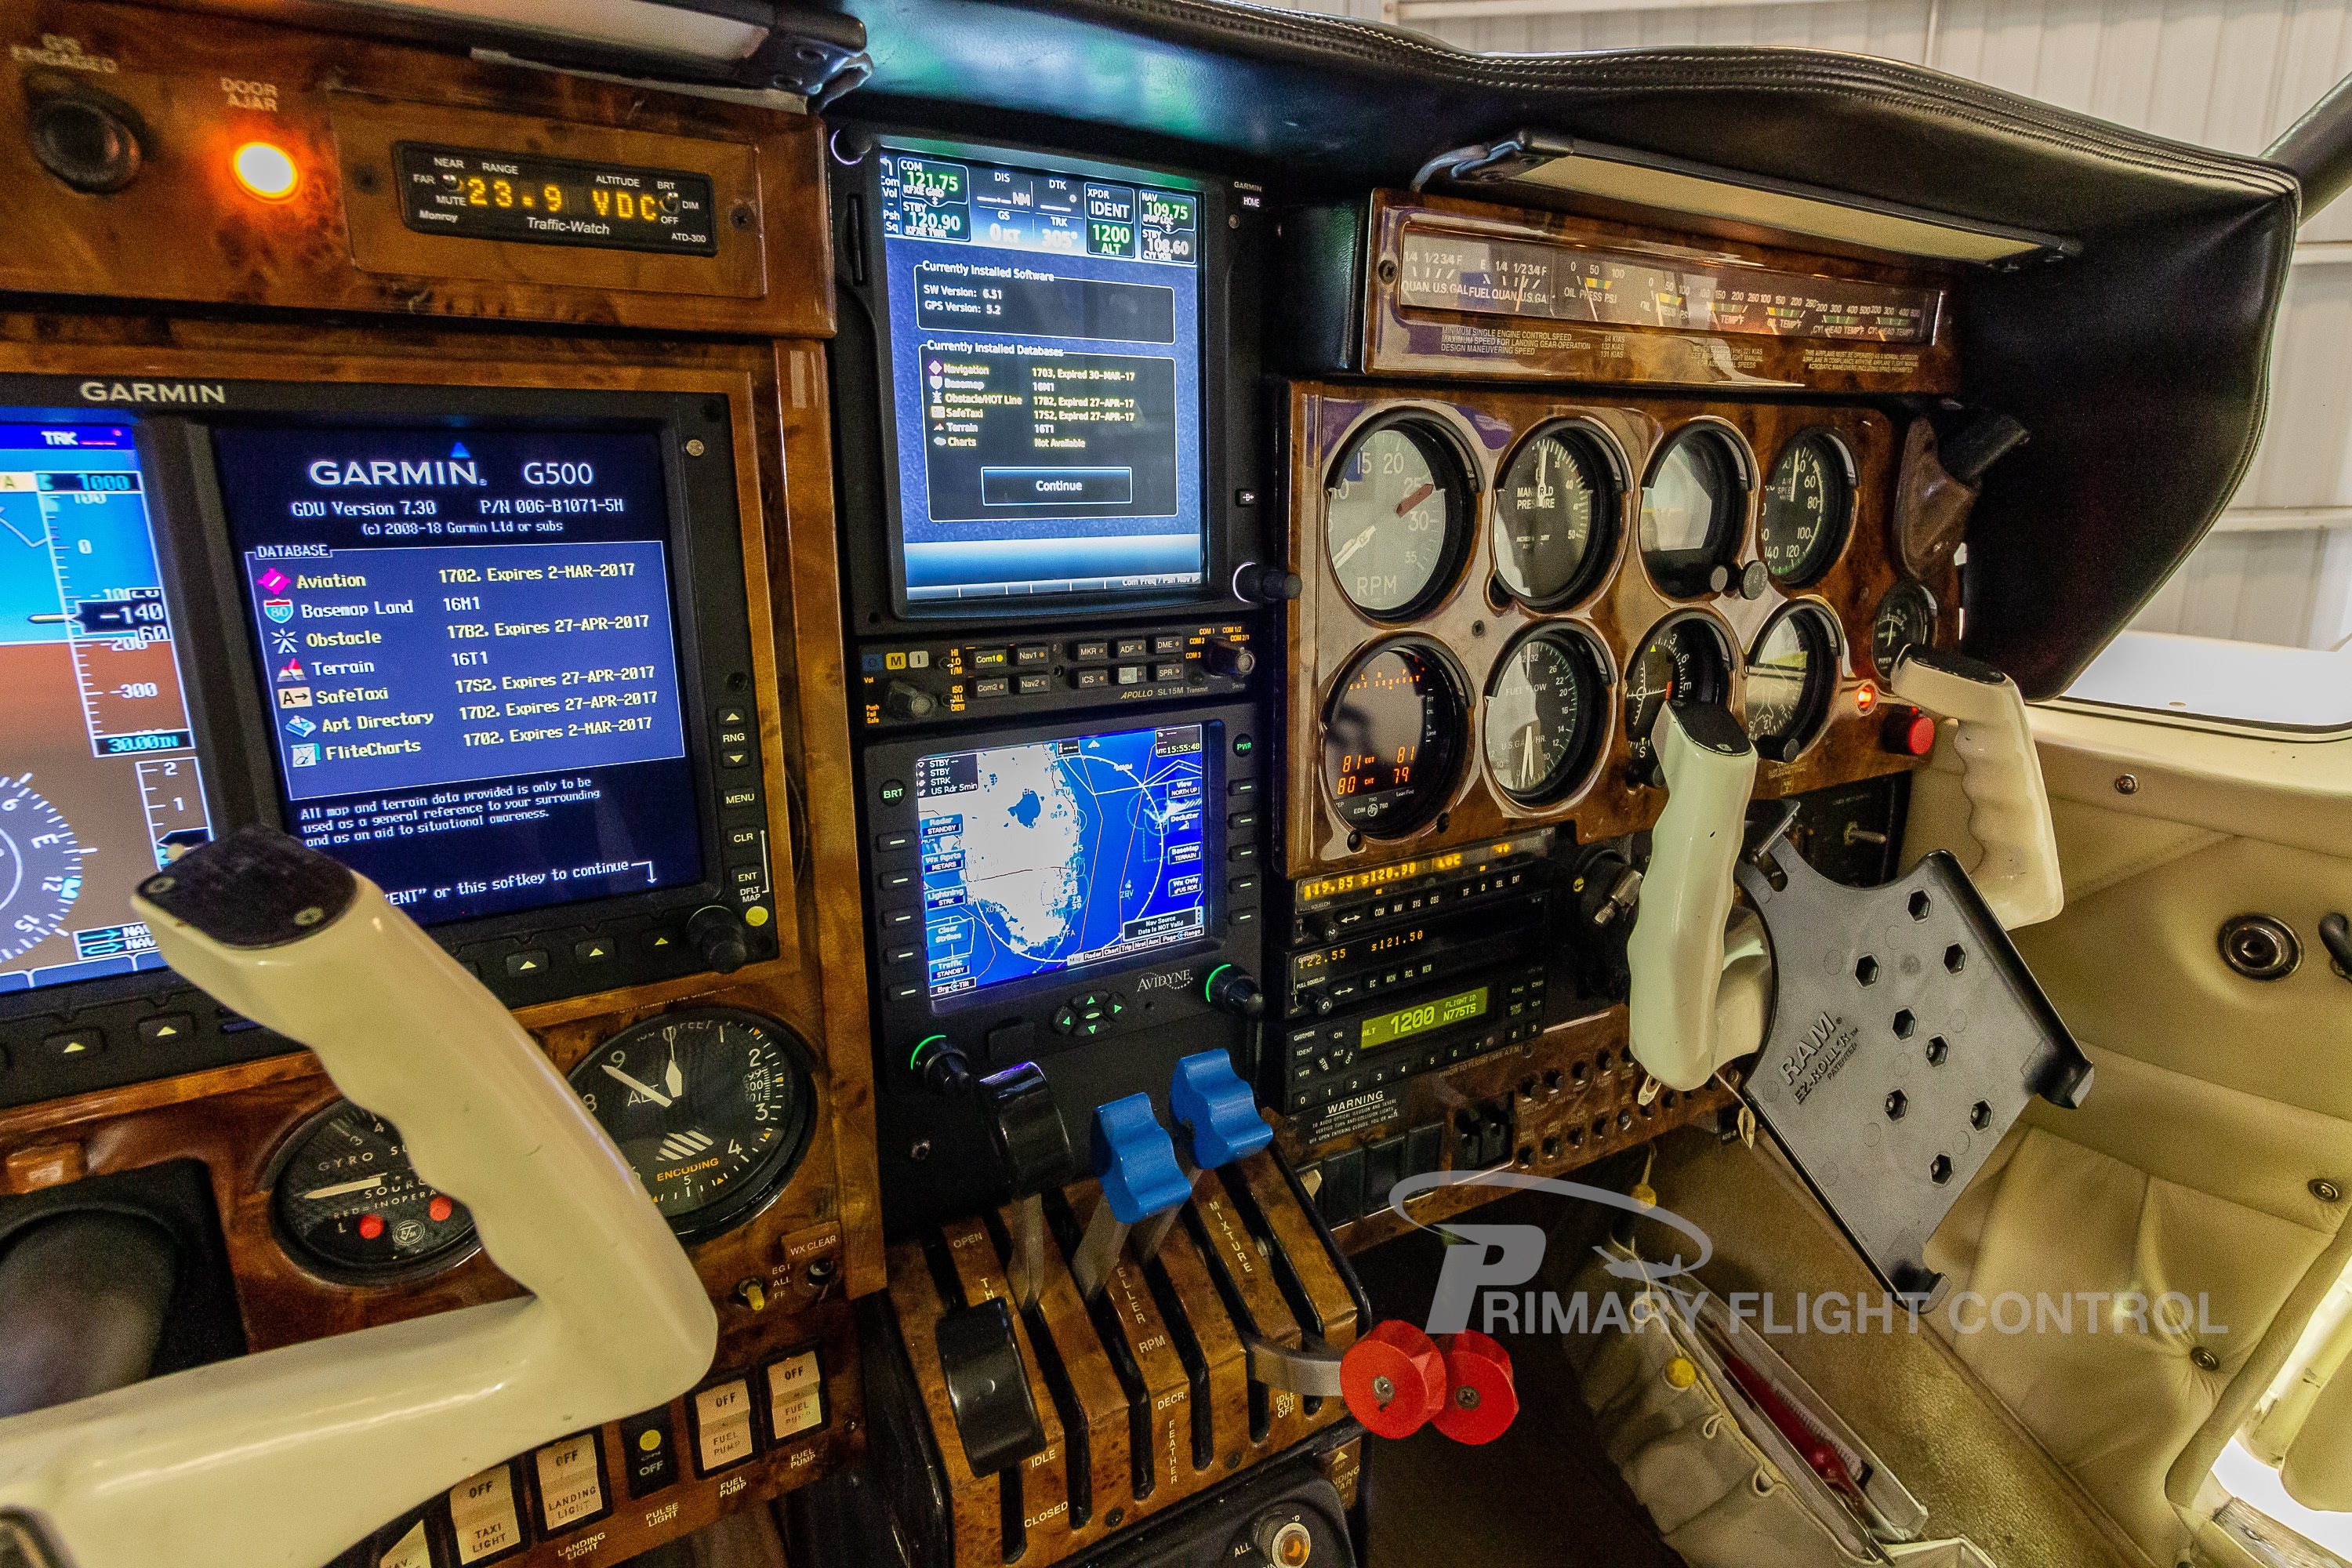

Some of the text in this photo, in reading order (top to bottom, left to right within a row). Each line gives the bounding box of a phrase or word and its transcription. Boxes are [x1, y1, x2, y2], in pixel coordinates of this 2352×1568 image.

[221, 77, 278, 98] DOOR
[228, 94, 278, 112] AJAR
[434, 158, 464, 169] NEAR
[482, 162, 518, 176] RANGE
[901, 160, 922, 172] COM
[413, 174, 435, 183] FAR
[596, 175, 640, 187] ALTITUDE
[657, 181, 675, 191] BRT
[907, 171, 958, 191] 121.75
[994, 172, 1010, 183] DIS
[1049, 180, 1066, 191] DTK
[1087, 188, 1109, 199] XPDR
[1234, 181, 1262, 192] GARMIN
[436, 195, 466, 206] MUTE
[591, 189, 657, 222] VDC
[682, 201, 699, 210] DIM
[1142, 192, 1157, 202] NAV
[1243, 197, 1260, 207] HOME
[903, 201, 927, 213] STBY
[1091, 201, 1130, 219] IDENT
[1146, 202, 1189, 220] 109.75
[419, 209, 458, 223] Monroy
[660, 216, 679, 225] OFF
[909, 212, 960, 231] 120.90
[1051, 216, 1068, 227] TRK
[527, 216, 610, 235] Traffic-Watch
[1092, 224, 1131, 244] 1200
[671, 233, 706, 244] ATD-300
[1102, 242, 1121, 255] ALT
[922, 260, 1054, 281] Currently Installed Software
[924, 284, 1002, 299] SW Version: 6.51
[924, 300, 1001, 315] GPS Version: 5.2
[927, 339, 1065, 357] Currently Installed Databases
[80, 381, 226, 405] GARMIN
[41, 430, 78, 446] TRK
[948, 437, 1085, 448] Charts Not Available
[1384, 453, 1404, 474] 20
[310, 460, 593, 487] GARMIN G500
[1804, 476, 1816, 488] 60
[80, 474, 131, 492] 1000
[1036, 480, 1083, 492] Continue
[291, 500, 436, 517] GDU Version 7.30
[1807, 496, 1818, 509] 80
[1409, 512, 1429, 531] 30
[1797, 527, 1811, 539] 100
[256, 544, 328, 559] DATABASE
[1786, 545, 1800, 557] 120
[296, 572, 366, 590] Aviation
[487, 566, 543, 583] Expires
[548, 561, 635, 580] 2-MAR-2017
[1357, 576, 1397, 597] RPM
[301, 599, 414, 619] Basemap Land
[306, 630, 382, 648] Obstacle
[495, 620, 550, 637] Expires
[554, 614, 650, 633] 27-APR-2017
[1157, 641, 1173, 649] DME
[312, 652, 488, 677] Terrain 16T1
[976, 655, 996, 663] Com1
[1082, 675, 1094, 684] ICS
[1159, 669, 1173, 677] SPR
[978, 683, 997, 691] Com2
[1022, 680, 1040, 688] Nav2
[317, 687, 389, 705] SafeTaxi
[1120, 687, 1183, 699] APOLLO SL15M
[322, 710, 434, 734] Apt Directory
[722, 732, 746, 743] RNG
[1553, 737, 1560, 746] 12
[325, 739, 422, 761] FliteCharts
[1167, 742, 1200, 753] 15:55:48
[931, 777, 951, 786] STRK
[1394, 767, 1409, 784] 79
[884, 789, 903, 798] BRT
[1338, 776, 1356, 795] 80
[726, 793, 755, 804] MENU
[733, 833, 753, 843] CLR
[434, 858, 630, 899] or this softkey to continue
[738, 872, 757, 882] ENT
[740, 886, 760, 896] DFLT
[742, 893, 760, 902] MAP
[1137, 969, 1190, 991] AVIDYNE
[1362, 1006, 1434, 1037] ALT 1200
[1443, 1004, 1475, 1022] N775TS
[1294, 1030, 1315, 1041] GARMIN
[1297, 1047, 1313, 1056] IDENT
[1778, 1011, 1835, 1086] RAM
[750, 1048, 761, 1067] 2
[1828, 1043, 1857, 1080] PATENTED
[1327, 1091, 1383, 1114] WARNING
[755, 1103, 768, 1120] 3
[728, 1138, 742, 1155] 4
[318, 1152, 373, 1171] GYRO
[656, 1157, 719, 1182] ENCODING
[953, 1232, 982, 1249] OPEN
[1209, 1200, 1254, 1273] MIXTURE
[789, 1235, 837, 1257] WX CLEAR
[773, 1276, 791, 1288] ALL
[1138, 1334, 1166, 1354] RPM
[784, 1366, 804, 1380] OFF
[716, 1392, 736, 1407] OFF
[1156, 1392, 1187, 1410] DECR.
[1030, 1449, 1057, 1468] IDLE
[1169, 1420, 1178, 1484] FEATHER
[469, 1480, 493, 1498] OFF
[548, 1486, 597, 1511] LANDING
[646, 1502, 679, 1521] PULSE
[648, 1510, 677, 1527] LIGHT
[1024, 1501, 1069, 1528] CLOSED
[475, 1523, 502, 1541] TAXI
[473, 1533, 506, 1552] LIGHT
[557, 1532, 605, 1557] LANDING
